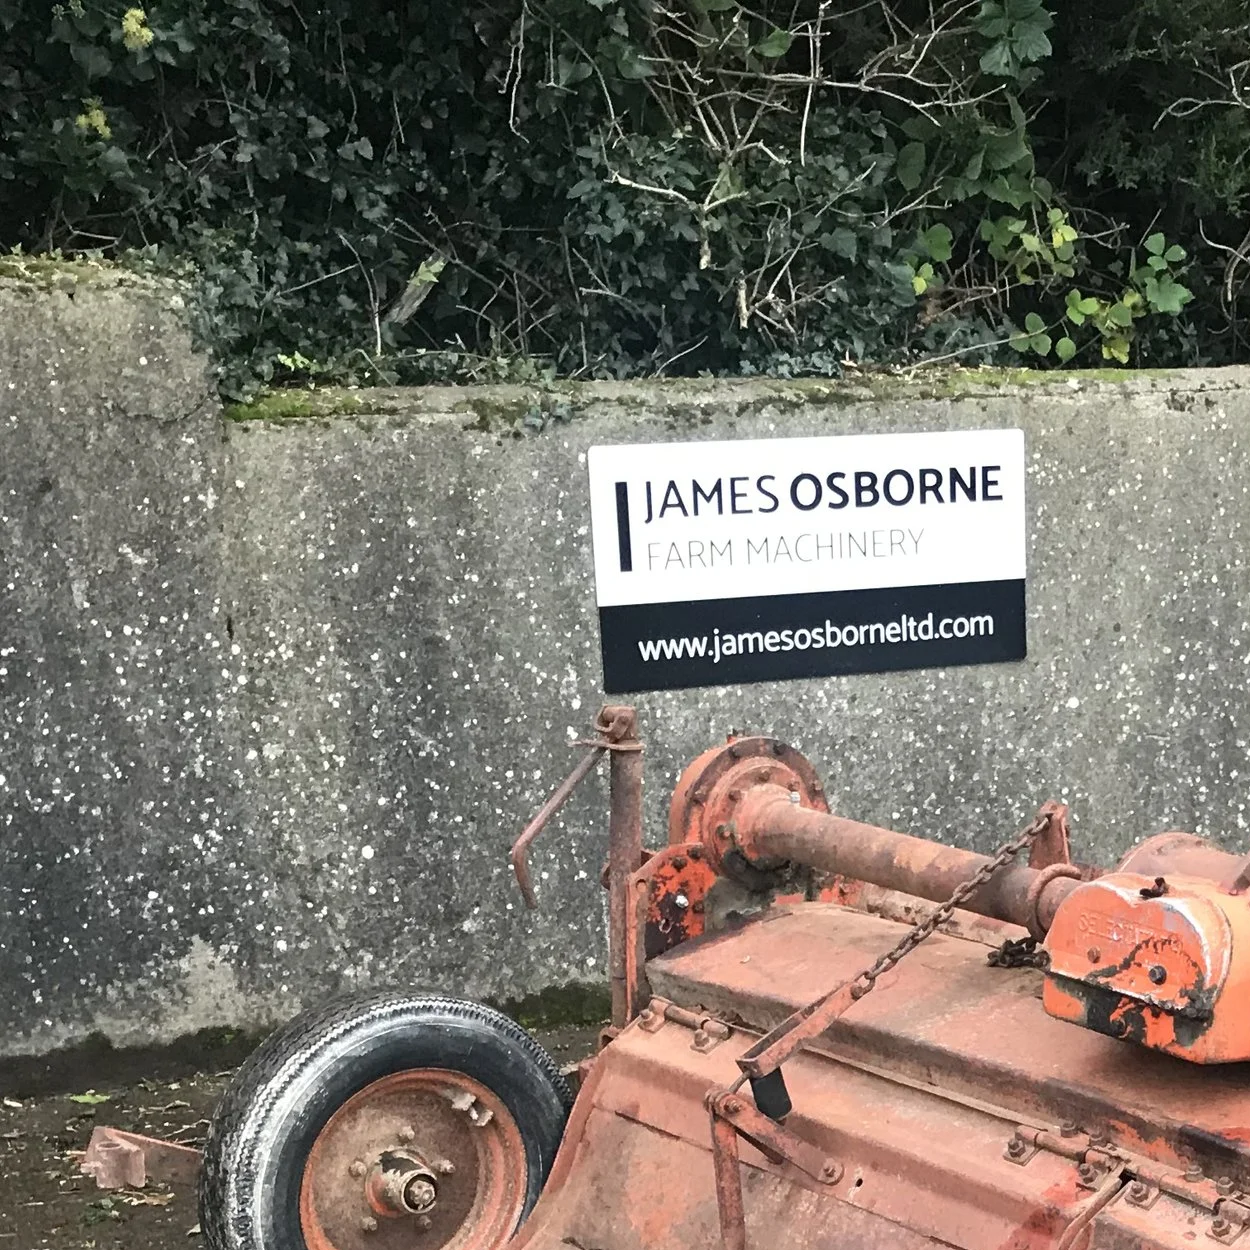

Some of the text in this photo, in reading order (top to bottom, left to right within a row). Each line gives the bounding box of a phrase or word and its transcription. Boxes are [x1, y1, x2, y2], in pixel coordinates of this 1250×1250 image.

[645, 466, 1003, 524] JAMES OSBORNE
[648, 528, 924, 571] FARM MACHINERY
[638, 613, 994, 663] www.jamesosborneltd.com
